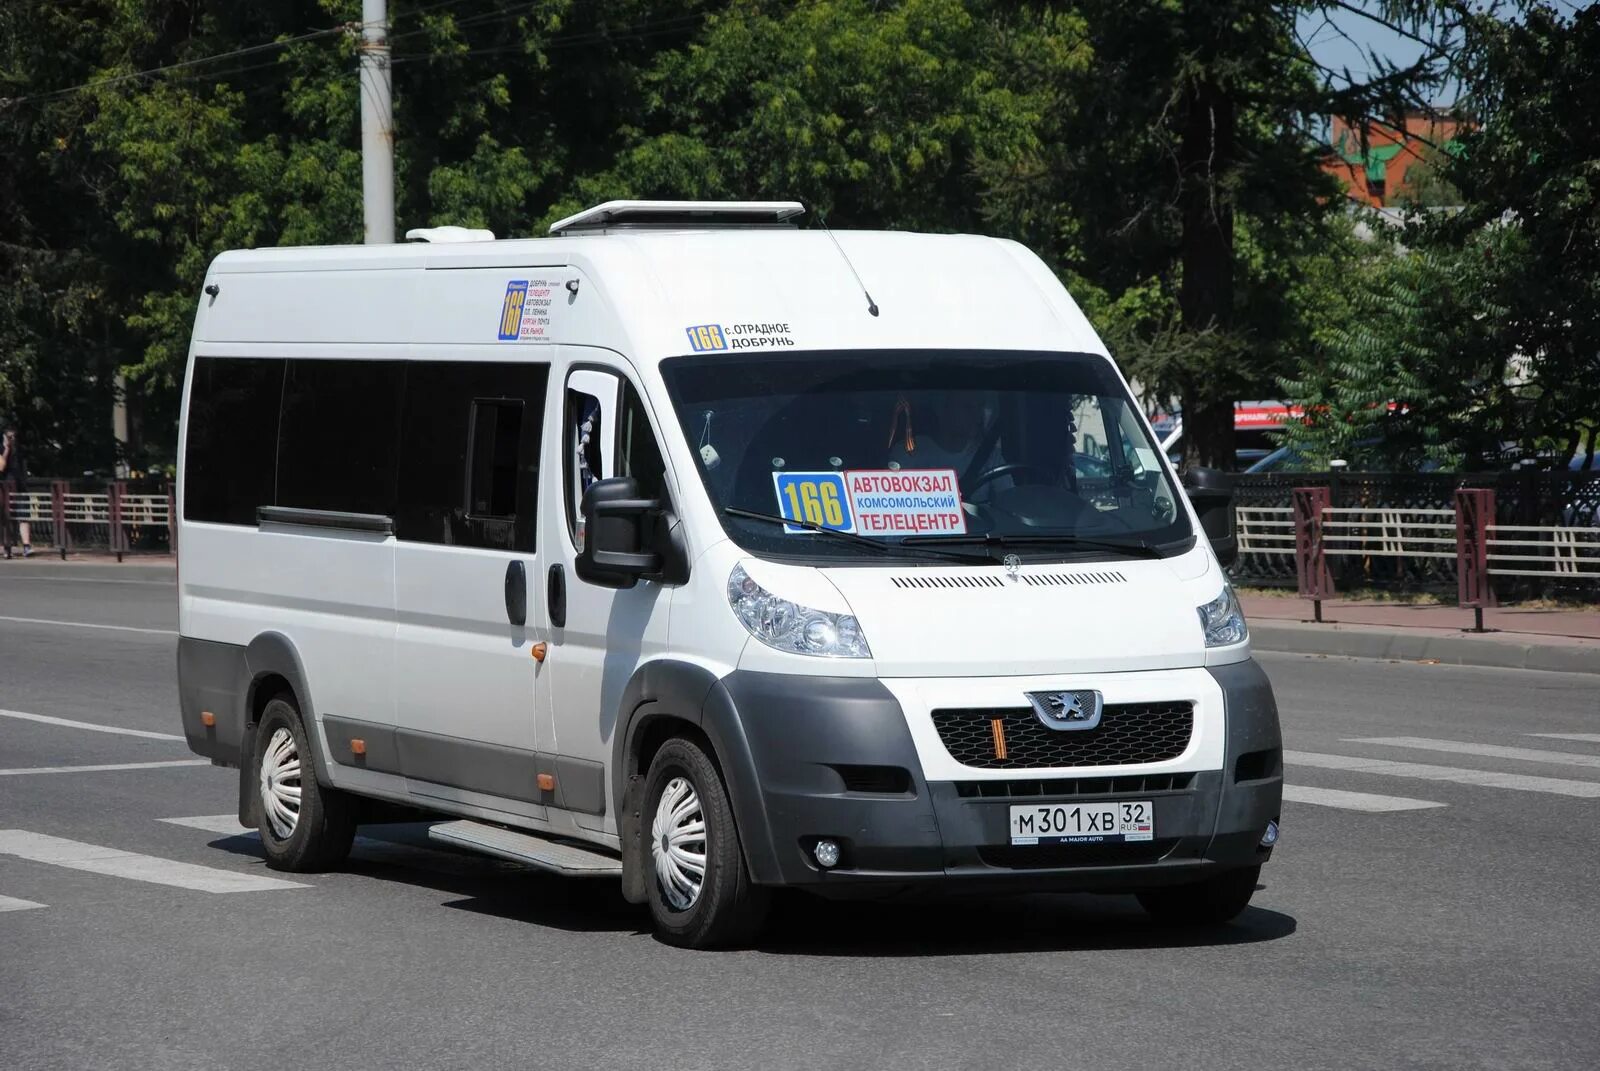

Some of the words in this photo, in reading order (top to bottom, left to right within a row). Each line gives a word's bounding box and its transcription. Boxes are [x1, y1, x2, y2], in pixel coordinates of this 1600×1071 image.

[501, 290, 524, 336] 166
[688, 326, 723, 350] 166
[724, 323, 791, 335] с.ОТРАДНОЕ
[731, 337, 794, 349] ДОБРУНЬ
[853, 475, 952, 493] АВТОВОКЗАЛ
[784, 481, 844, 527] 166
[857, 495, 955, 508] КОМСОМОЛЬСКИЙ
[860, 513, 960, 532] ТЕЛЕЦЕНТР
[1122, 804, 1144, 823] 32
[1121, 823, 1137, 831] RUS
